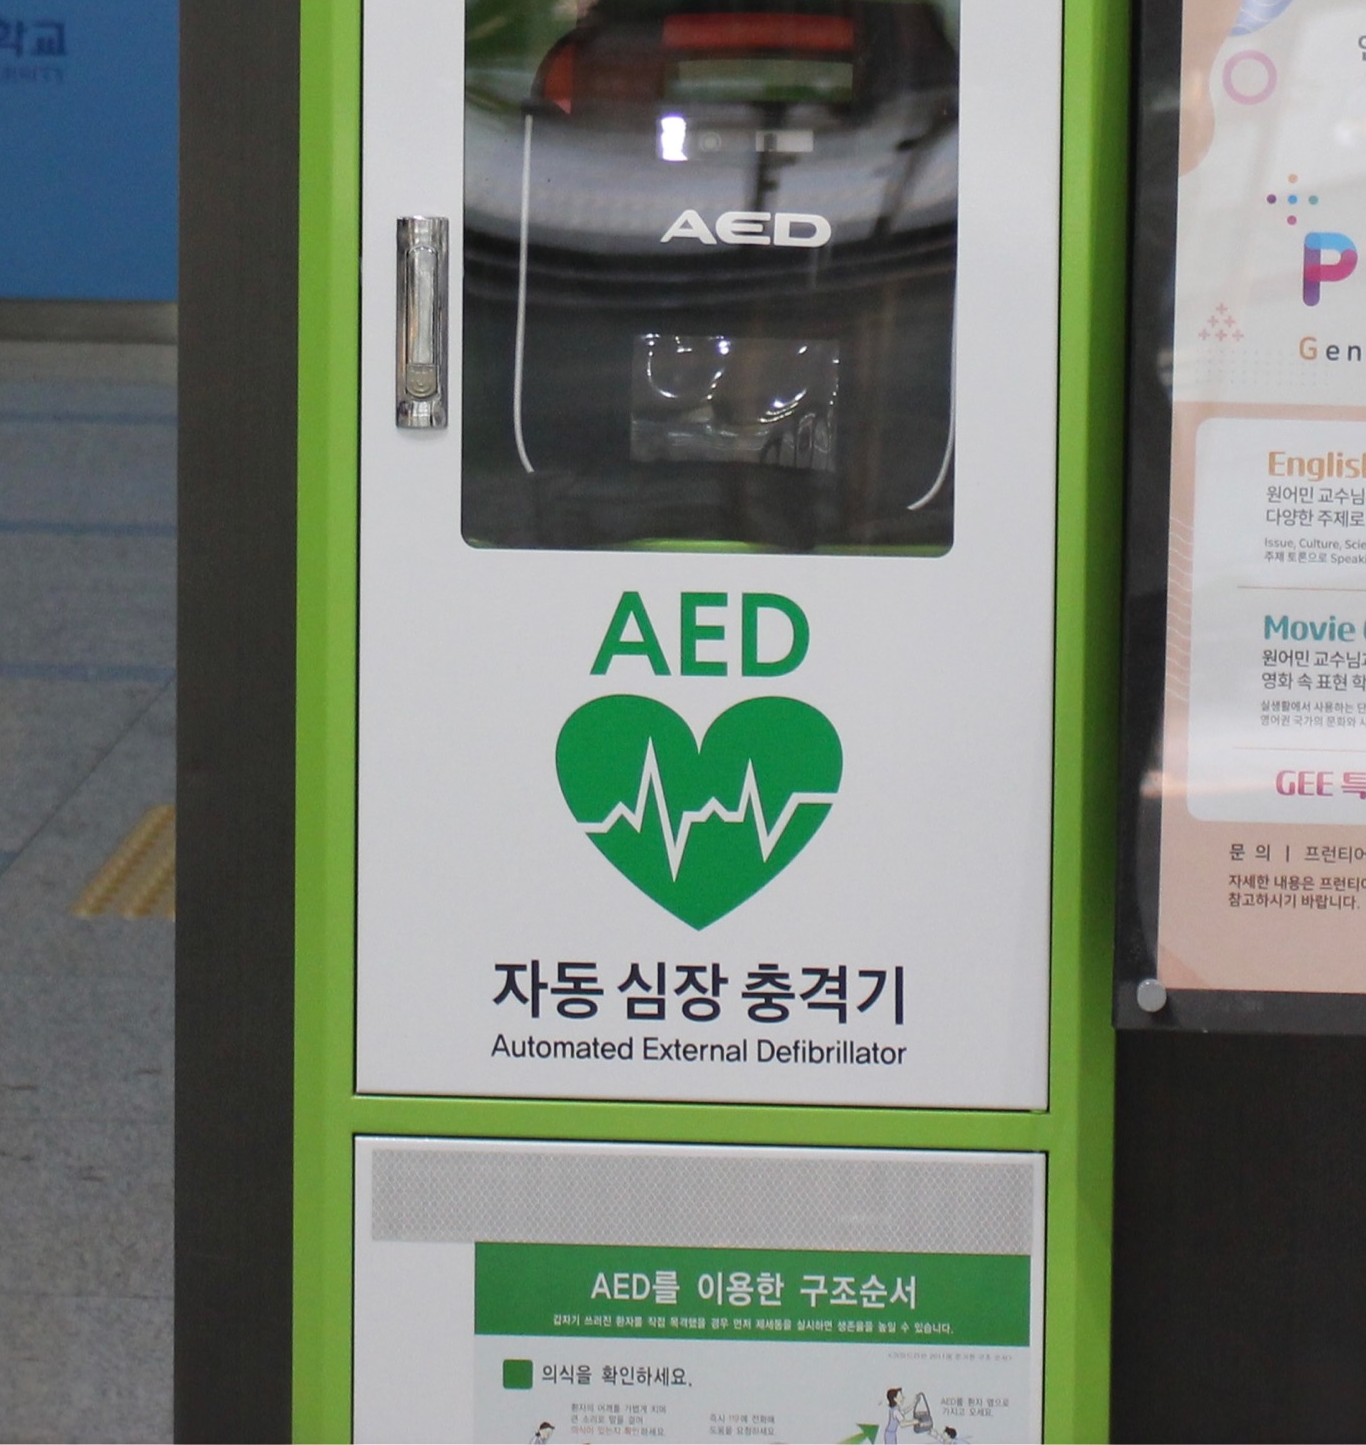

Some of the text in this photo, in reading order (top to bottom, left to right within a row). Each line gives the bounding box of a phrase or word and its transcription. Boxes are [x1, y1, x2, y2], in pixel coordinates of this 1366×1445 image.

[660, 210, 831, 248] AED
[1267, 485, 1314, 505] 원어민
[1267, 509, 1313, 527] 다양한
[1317, 511, 1365, 527] 주제로
[1265, 538, 1296, 551] Issue,
[1299, 539, 1342, 551] Culture,
[1287, 553, 1327, 564] 토론으로
[590, 591, 810, 677] AED
[1265, 615, 1355, 642] Movie
[1262, 649, 1309, 667] 원어민
[1261, 672, 1293, 690] 영화
[1297, 673, 1311, 690] 속
[1317, 674, 1347, 691] 표현
[1314, 701, 1353, 714] 사용하는
[1293, 715, 1323, 727] 국가의
[1276, 770, 1333, 797] GEE
[1229, 875, 1269, 891] 자세한
[1274, 876, 1314, 891] 내용은
[1228, 893, 1360, 910] 참고하시기 바랍니다.
[492, 960, 907, 1025] 자동 심장 충격기
[491, 1034, 907, 1066] Automated External Defibrillator
[591, 1270, 916, 1309] AED를 이용한 구조순서
[553, 1315, 580, 1326] 갑자기
[585, 1316, 611, 1327] 쓰러진
[797, 1319, 832, 1332] 실시하면
[915, 1322, 953, 1334] 있습니다.
[542, 1364, 692, 1387] 의식을 확인하세요.
